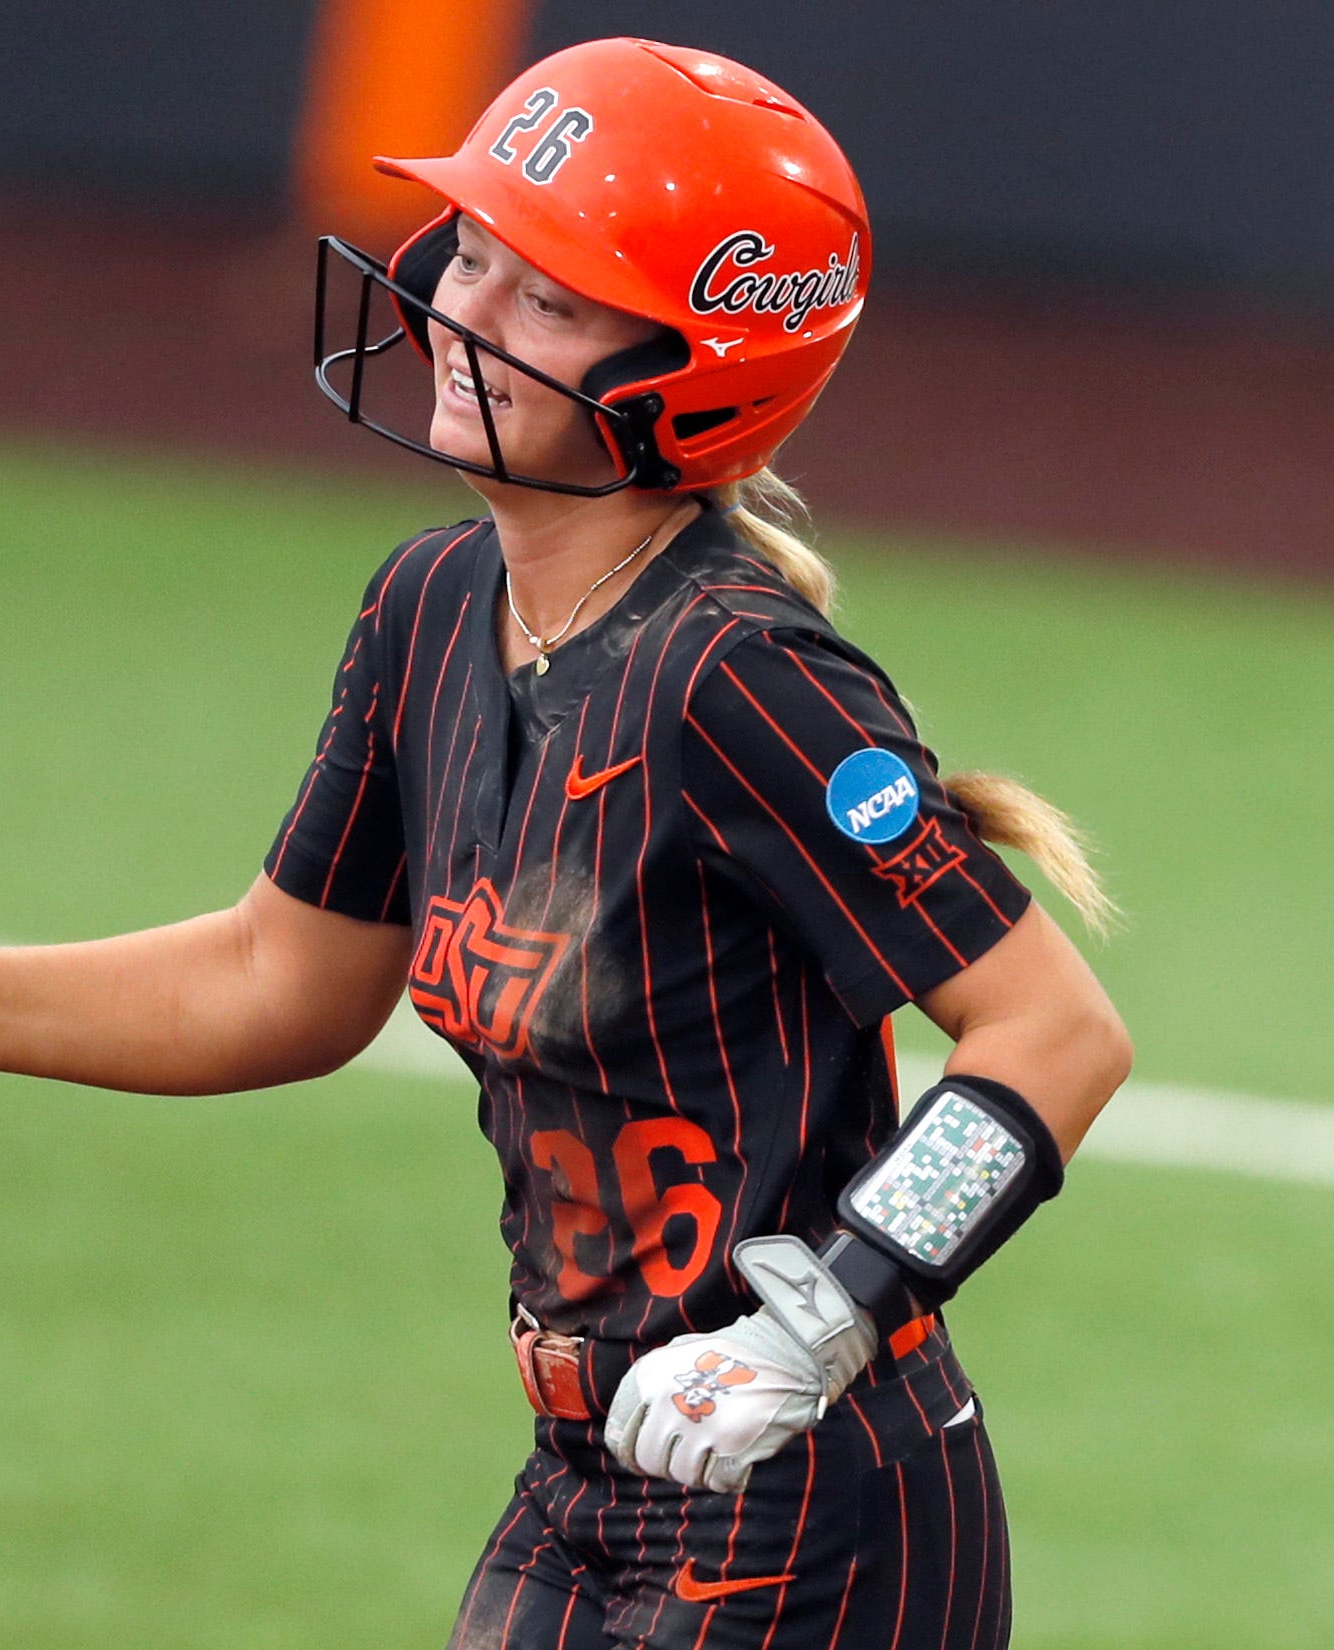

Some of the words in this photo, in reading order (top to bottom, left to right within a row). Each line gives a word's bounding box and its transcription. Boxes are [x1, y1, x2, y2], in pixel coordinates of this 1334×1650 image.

[490, 86, 594, 186] 26
[846, 775, 916, 835] NCAA
[530, 1116, 723, 1300] 26
